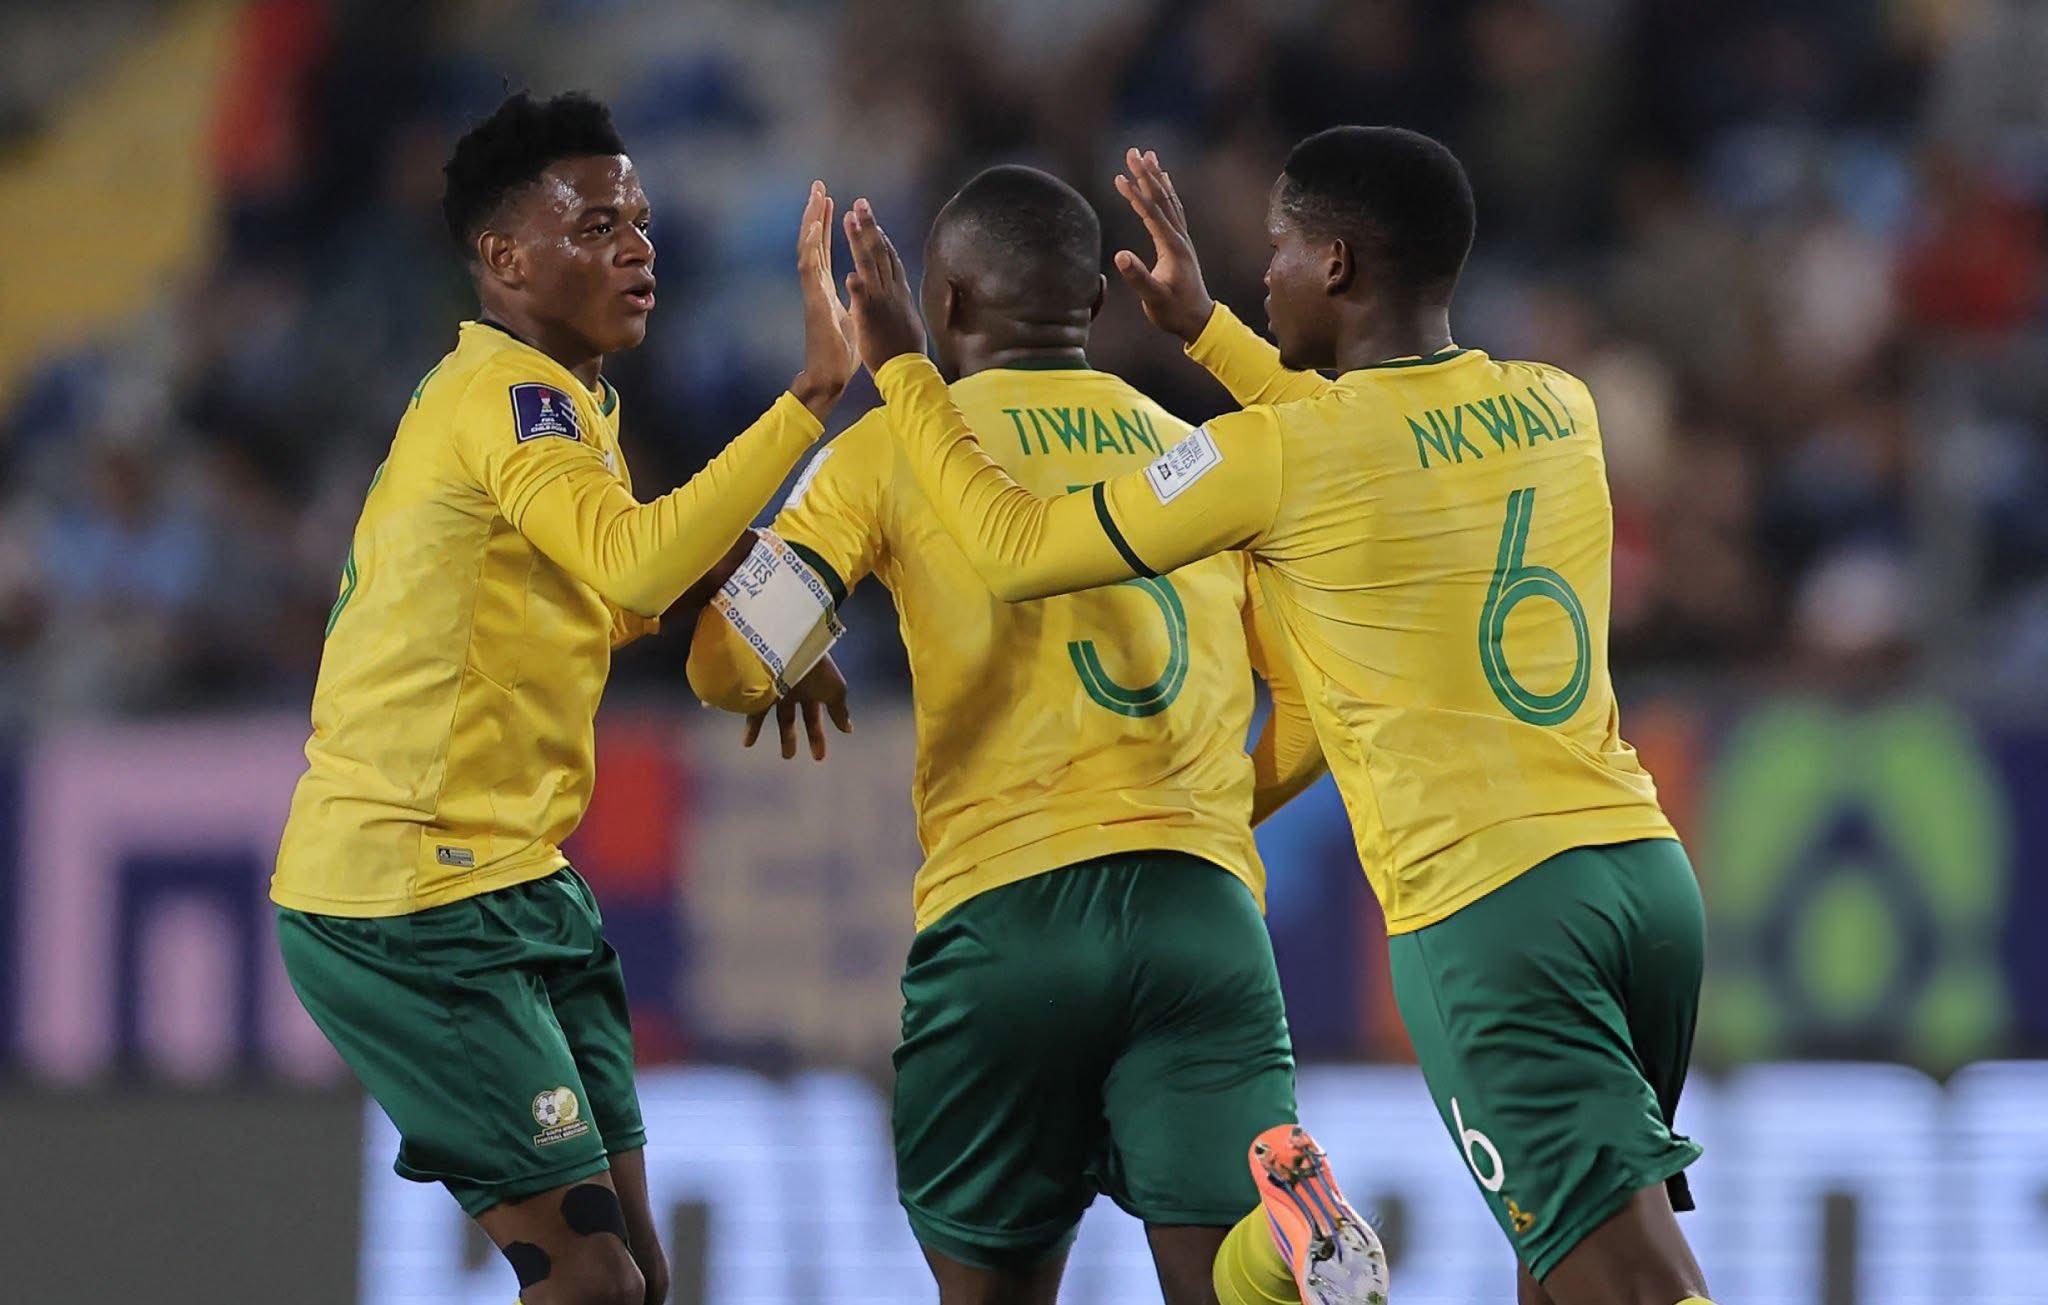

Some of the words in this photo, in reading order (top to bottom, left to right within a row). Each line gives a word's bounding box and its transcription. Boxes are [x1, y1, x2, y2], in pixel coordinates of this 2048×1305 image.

[1001, 406, 1165, 456] TIWANI
[742, 553, 773, 585] ITES
[1478, 486, 1591, 727] 6
[1450, 1096, 1505, 1192] 6
